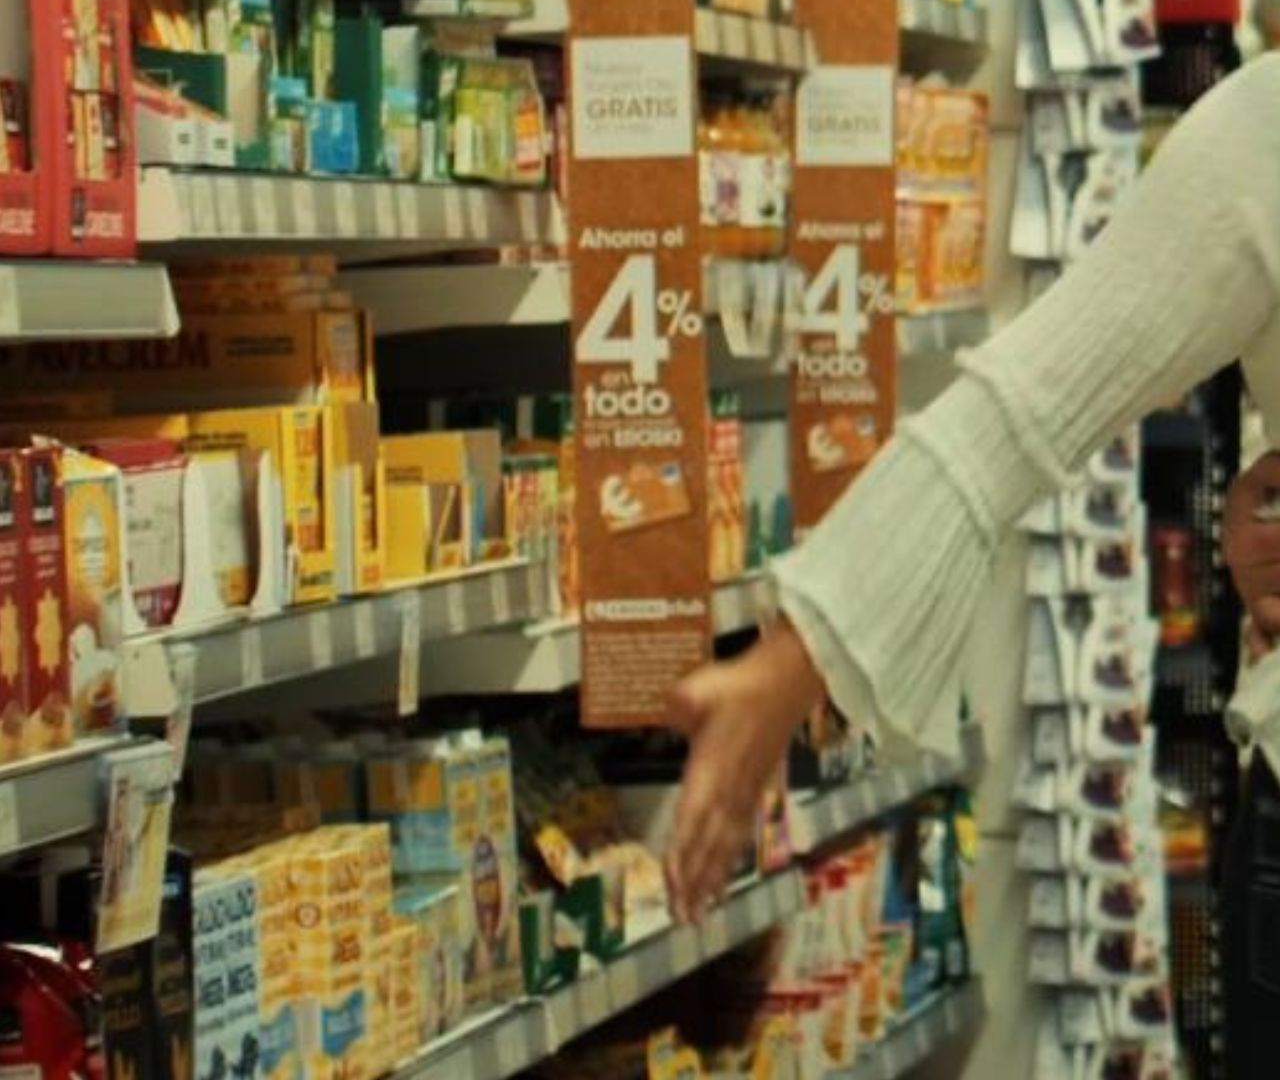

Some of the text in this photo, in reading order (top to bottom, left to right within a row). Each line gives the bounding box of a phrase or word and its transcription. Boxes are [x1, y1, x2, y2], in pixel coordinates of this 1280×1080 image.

[579, 227, 685, 251] Ahorra el
[575, 253, 702, 384] 4%
[797, 352, 868, 378] todo
[584, 382, 671, 418] todo
[613, 426, 684, 448] EROSKI
